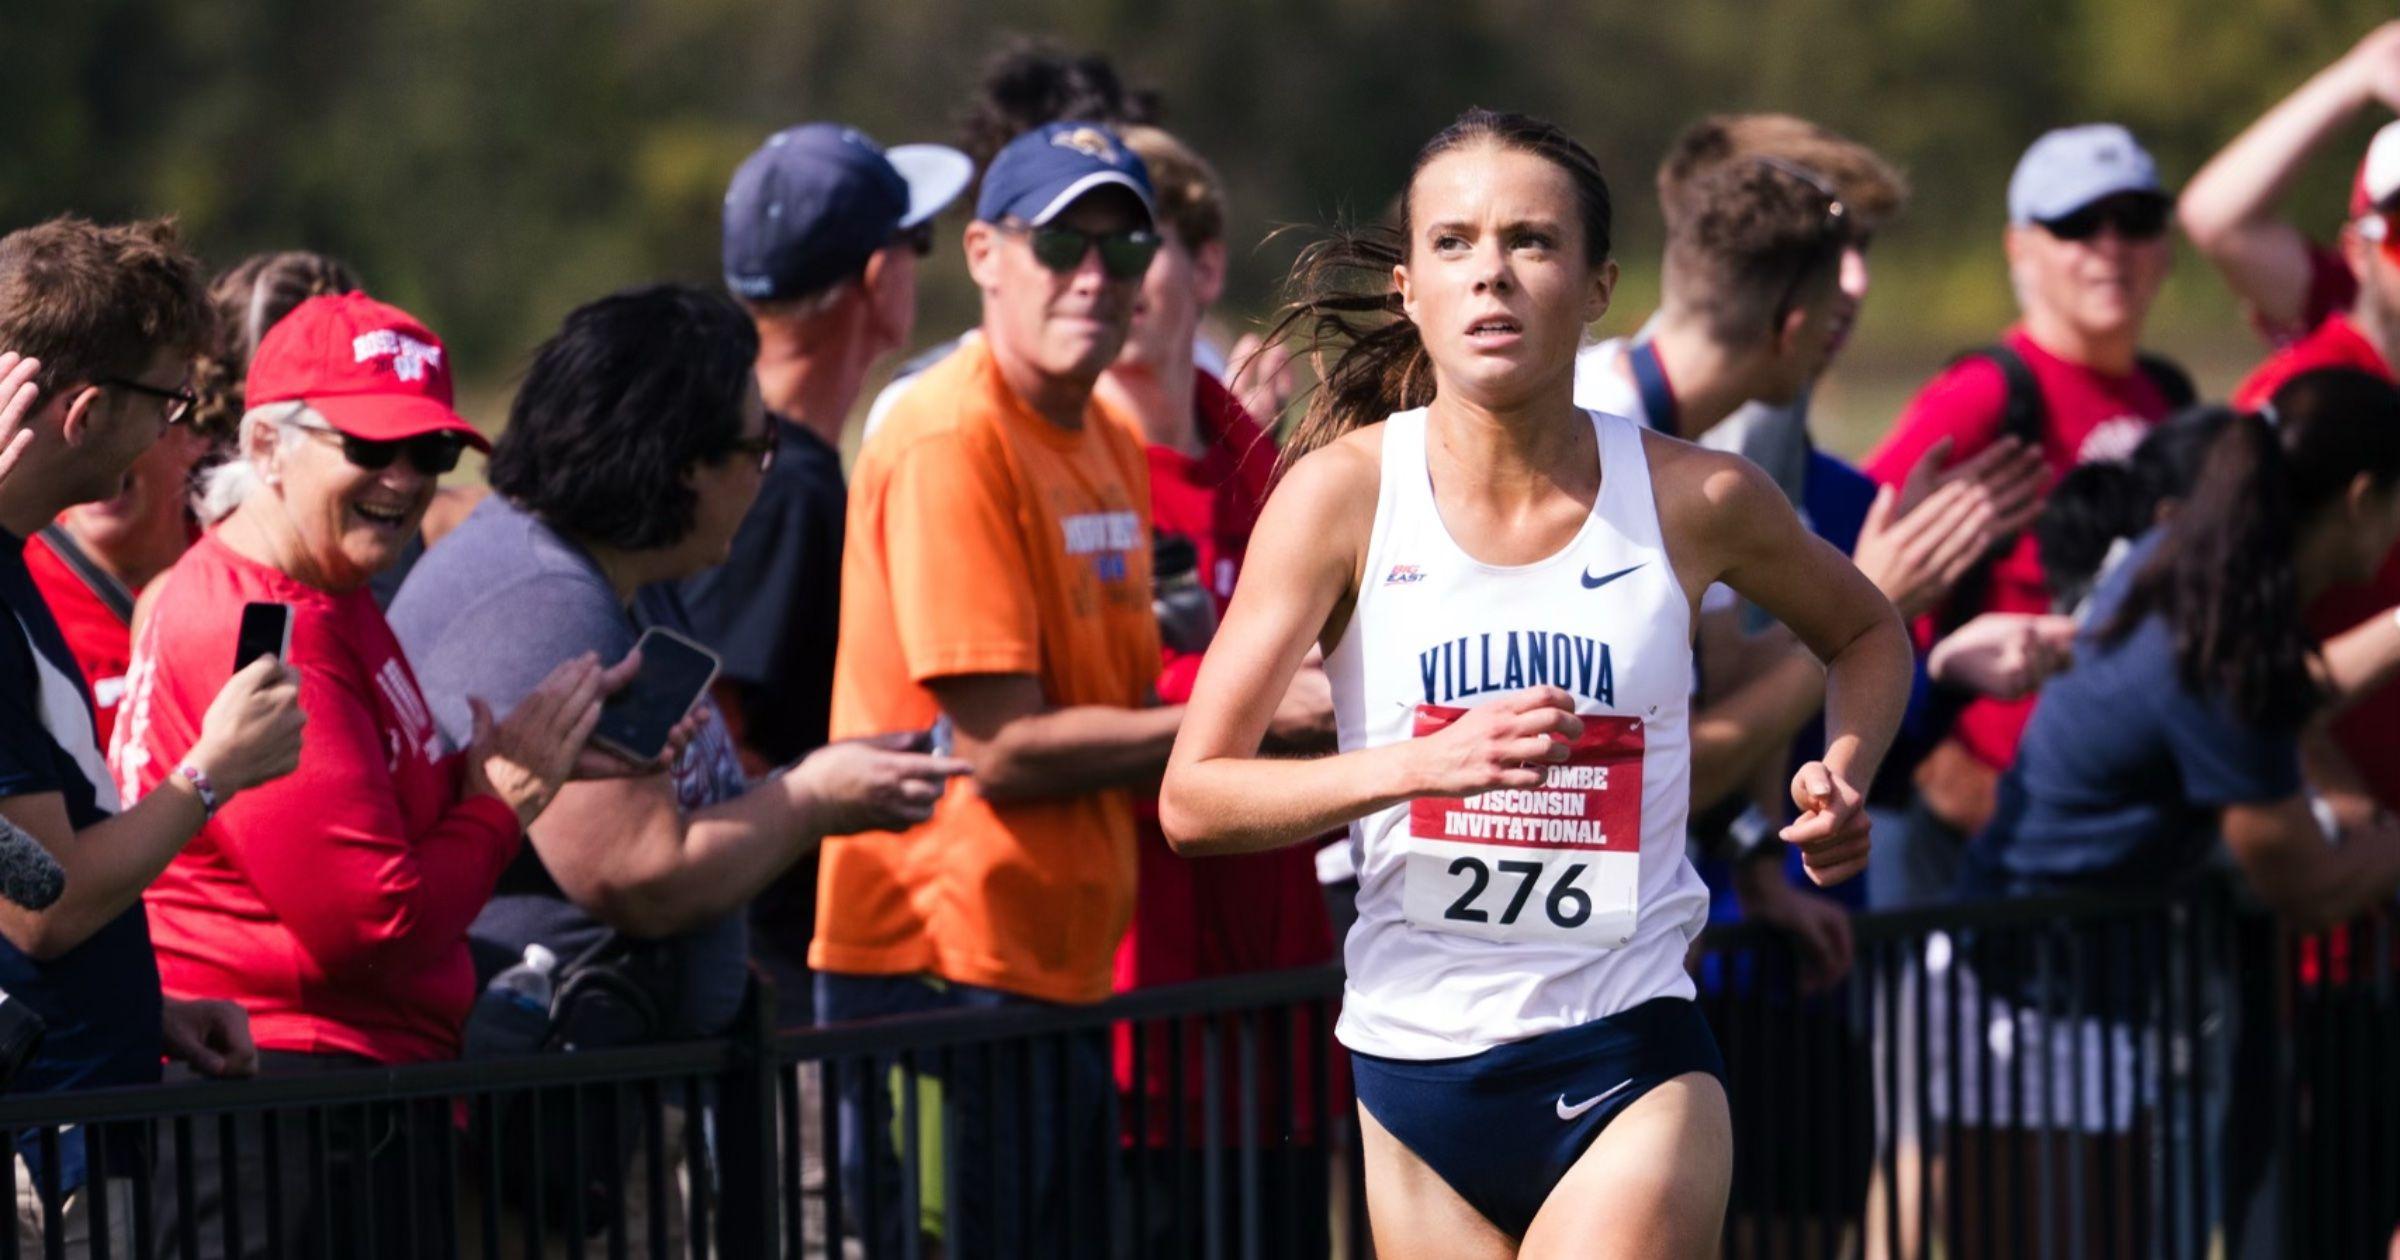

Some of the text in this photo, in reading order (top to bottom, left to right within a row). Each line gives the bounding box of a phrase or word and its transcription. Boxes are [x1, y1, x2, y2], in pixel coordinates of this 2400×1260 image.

[1386, 573, 1427, 582] EAST
[1419, 631, 1614, 708] VILLANOVA
[1463, 789, 1586, 816] WISCONSIN
[1445, 811, 1607, 844] INVITATIONAL
[1444, 856, 1592, 929] 276
